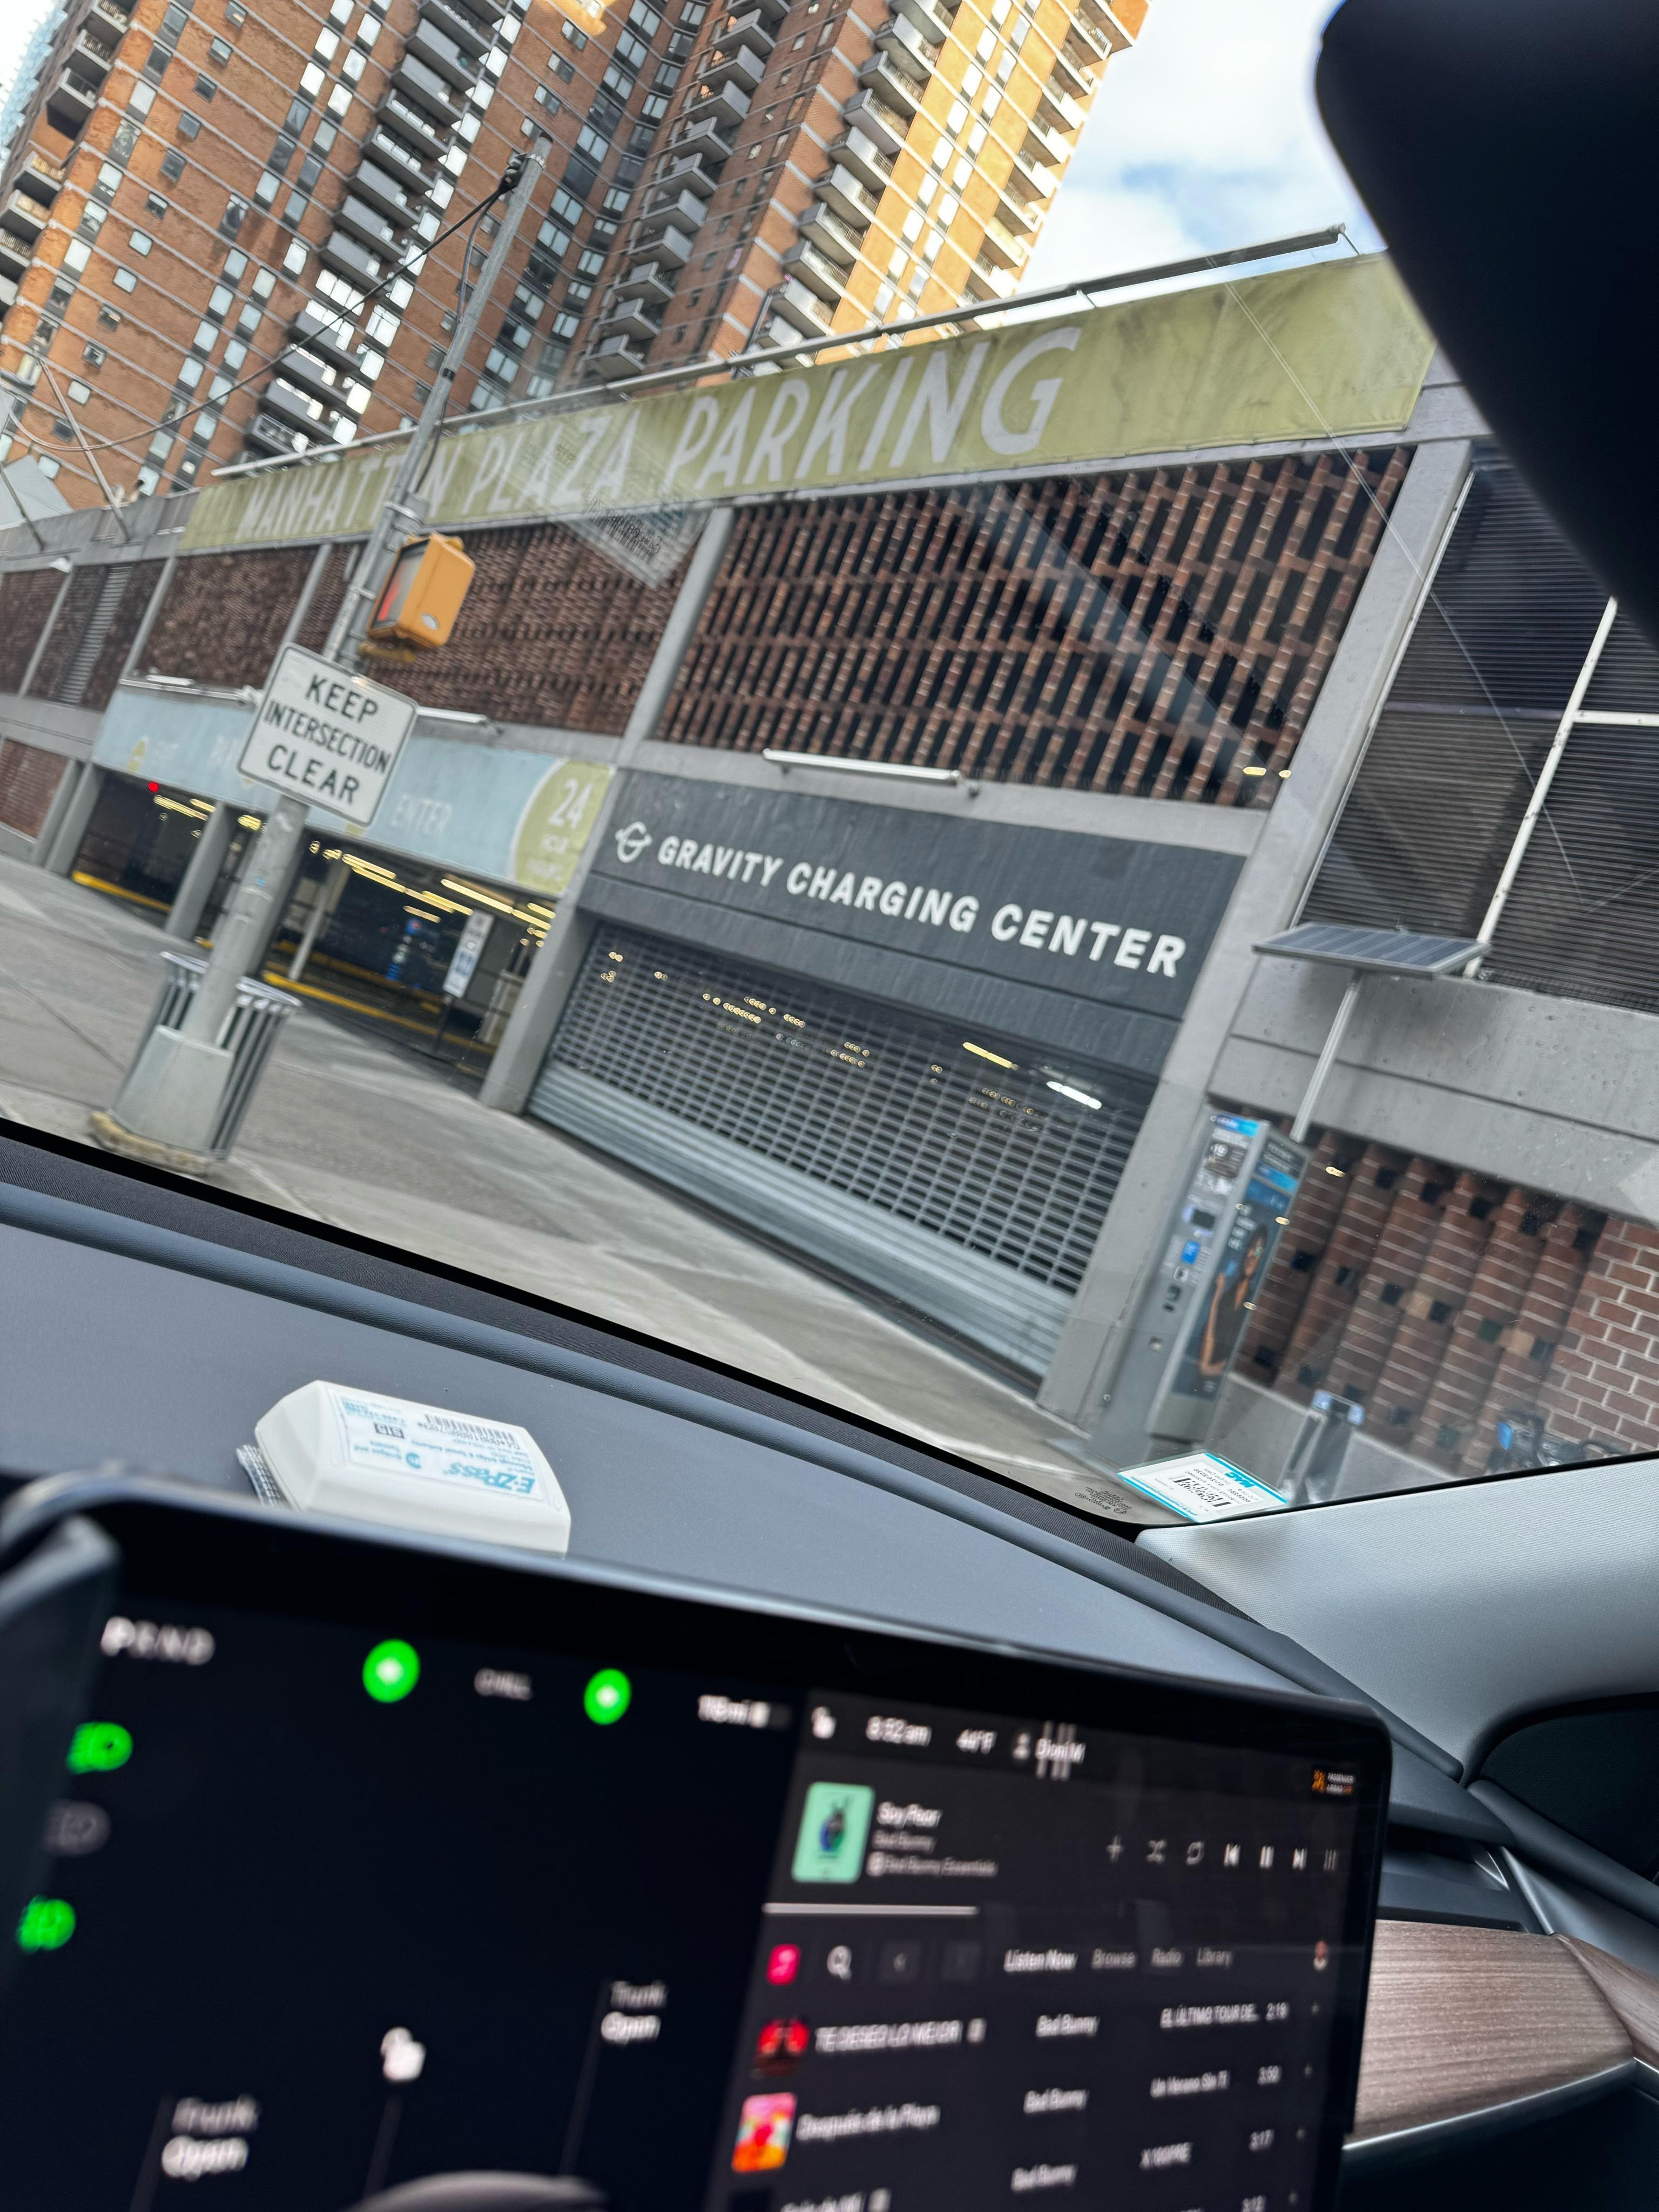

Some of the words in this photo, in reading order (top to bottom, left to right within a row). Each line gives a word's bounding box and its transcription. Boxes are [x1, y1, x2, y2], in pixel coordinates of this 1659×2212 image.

[233, 441, 464, 540] MANHATTN
[462, 408, 642, 515] PLAZA
[660, 327, 1082, 494] PARKING
[305, 674, 378, 724] KEEP
[264, 699, 392, 777] INTERSECTION
[267, 745, 360, 805] CLEAR
[549, 778, 592, 830] 24
[657, 835, 784, 887] GRAVITY
[786, 862, 980, 933] CHARGING
[991, 903, 1187, 979] CENTER
[1004, 1948, 1046, 1972] Listen
[1045, 1948, 1079, 1970] Now
[1092, 1947, 1137, 1971] Browse
[1150, 1947, 1185, 1968] Radio
[1196, 1947, 1235, 1970] Library
